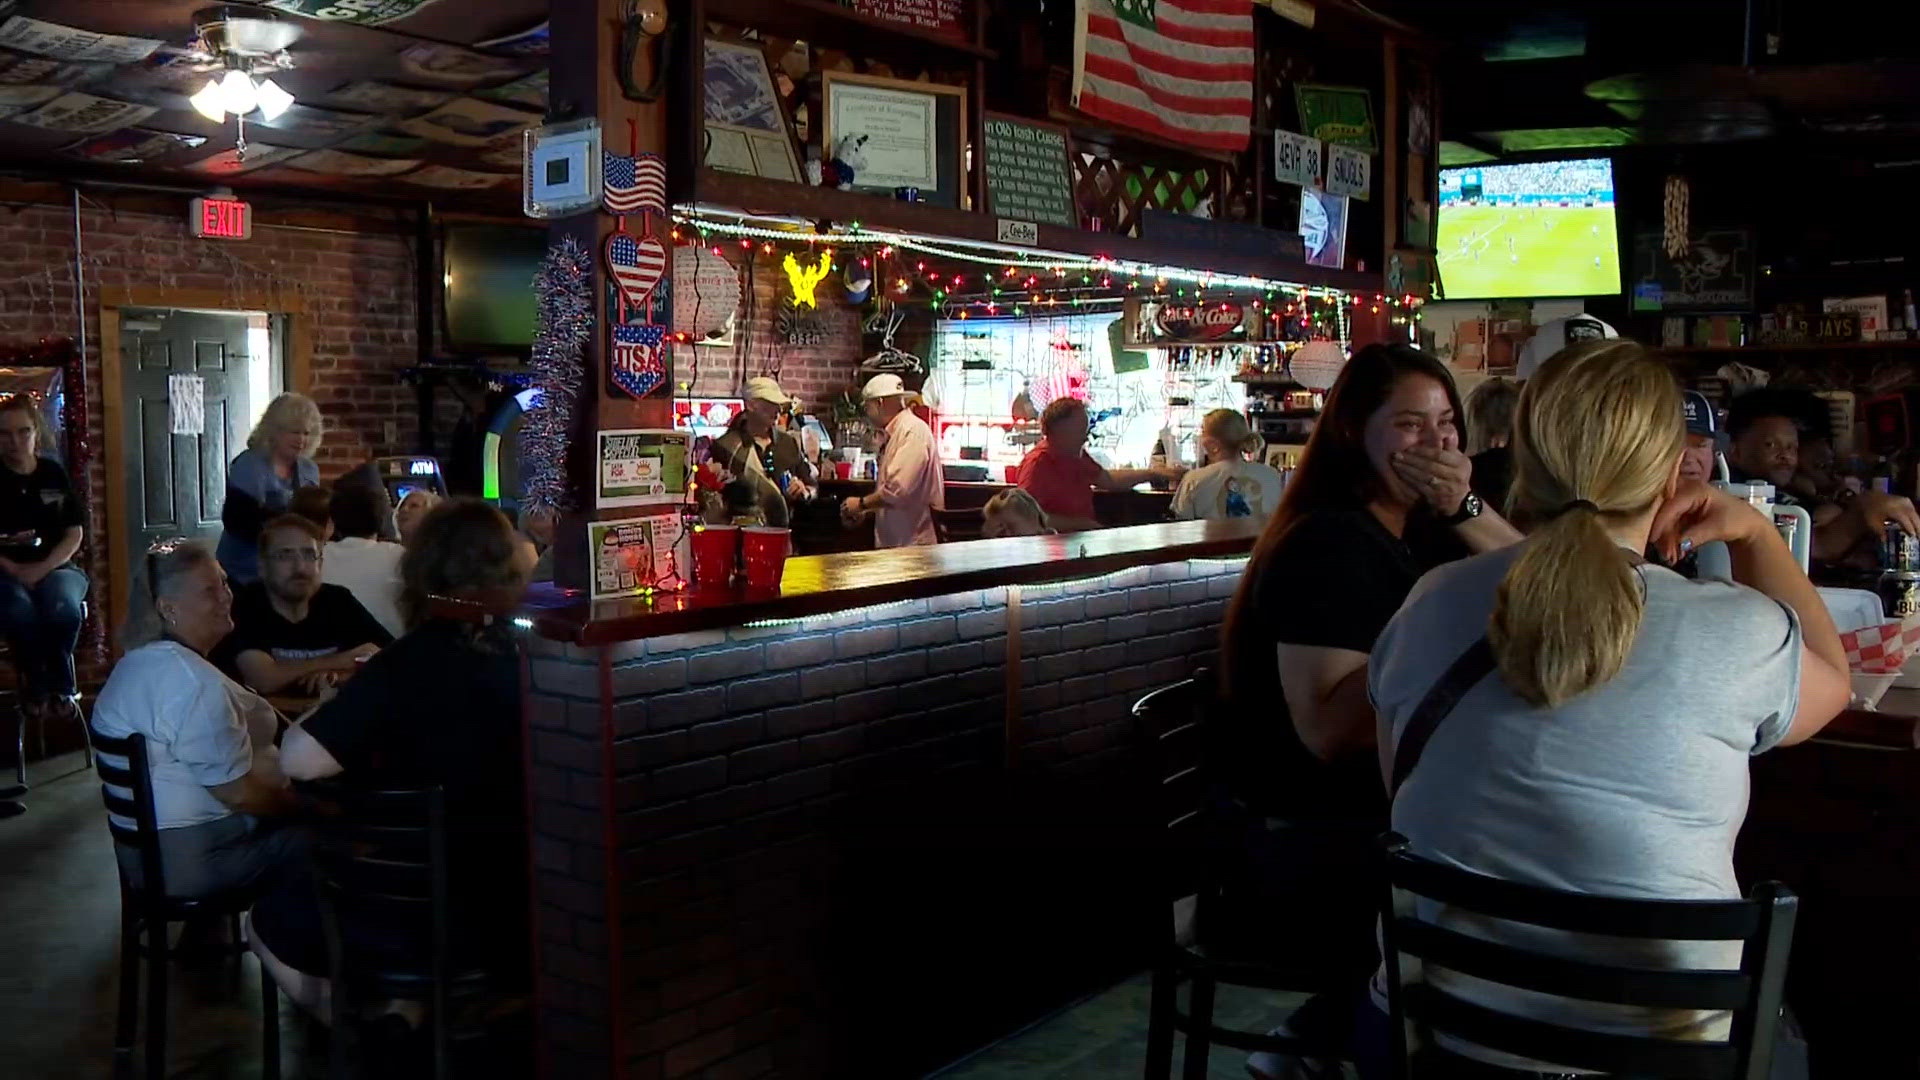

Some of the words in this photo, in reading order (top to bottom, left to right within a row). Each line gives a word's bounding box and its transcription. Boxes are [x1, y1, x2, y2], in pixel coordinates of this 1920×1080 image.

[1306, 148, 1318, 176] 38
[203, 199, 246, 237] EXIT
[617, 344, 660, 373] USA
[411, 460, 434, 475] ATM
[1899, 601, 1920, 614] BU
